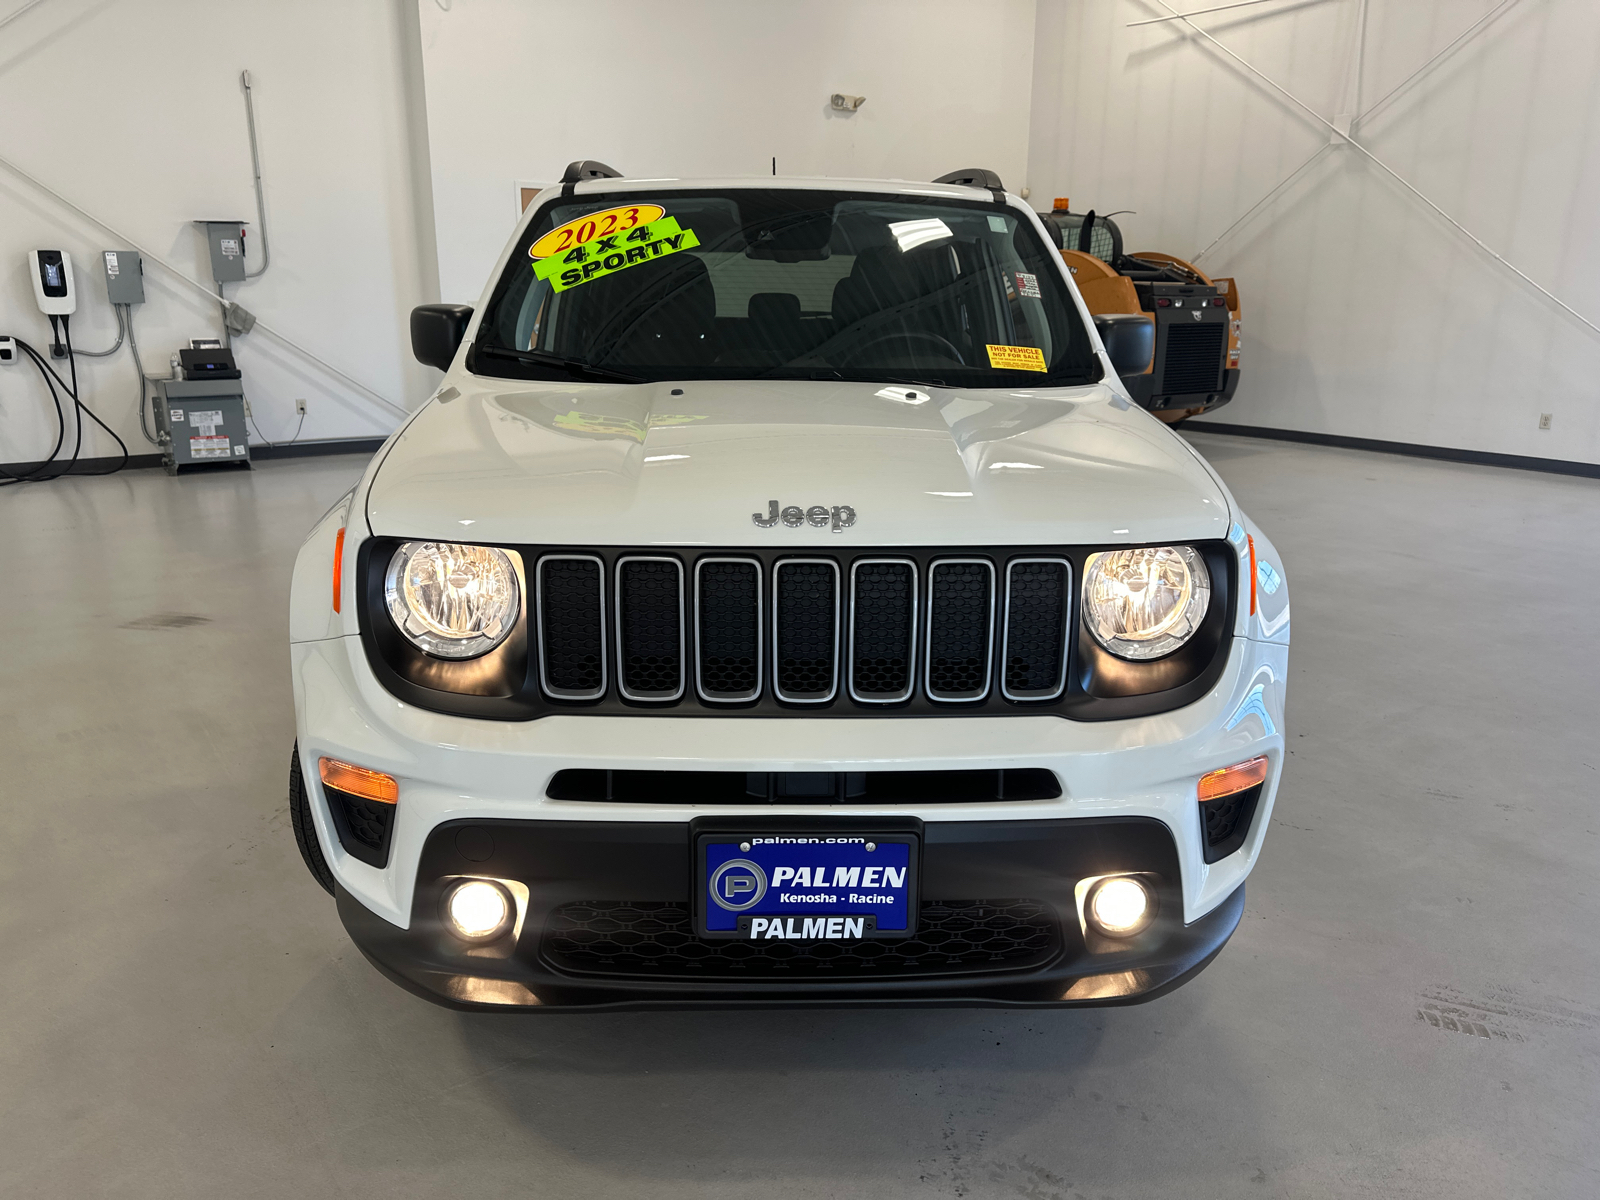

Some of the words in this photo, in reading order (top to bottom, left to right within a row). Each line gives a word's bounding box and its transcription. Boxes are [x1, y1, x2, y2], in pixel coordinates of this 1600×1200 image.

[554, 208, 639, 253] 2023
[562, 246, 590, 264] 4
[626, 226, 653, 243] 4
[560, 233, 685, 287] SPORTY
[1008, 347, 1041, 355] VEHICLE
[752, 500, 857, 533] Jeep
[752, 836, 865, 846] palmen.com
[771, 867, 906, 888] PALMEN
[780, 893, 837, 903] Kenosha
[849, 893, 894, 904] Racine
[750, 918, 864, 939] PALMEN
